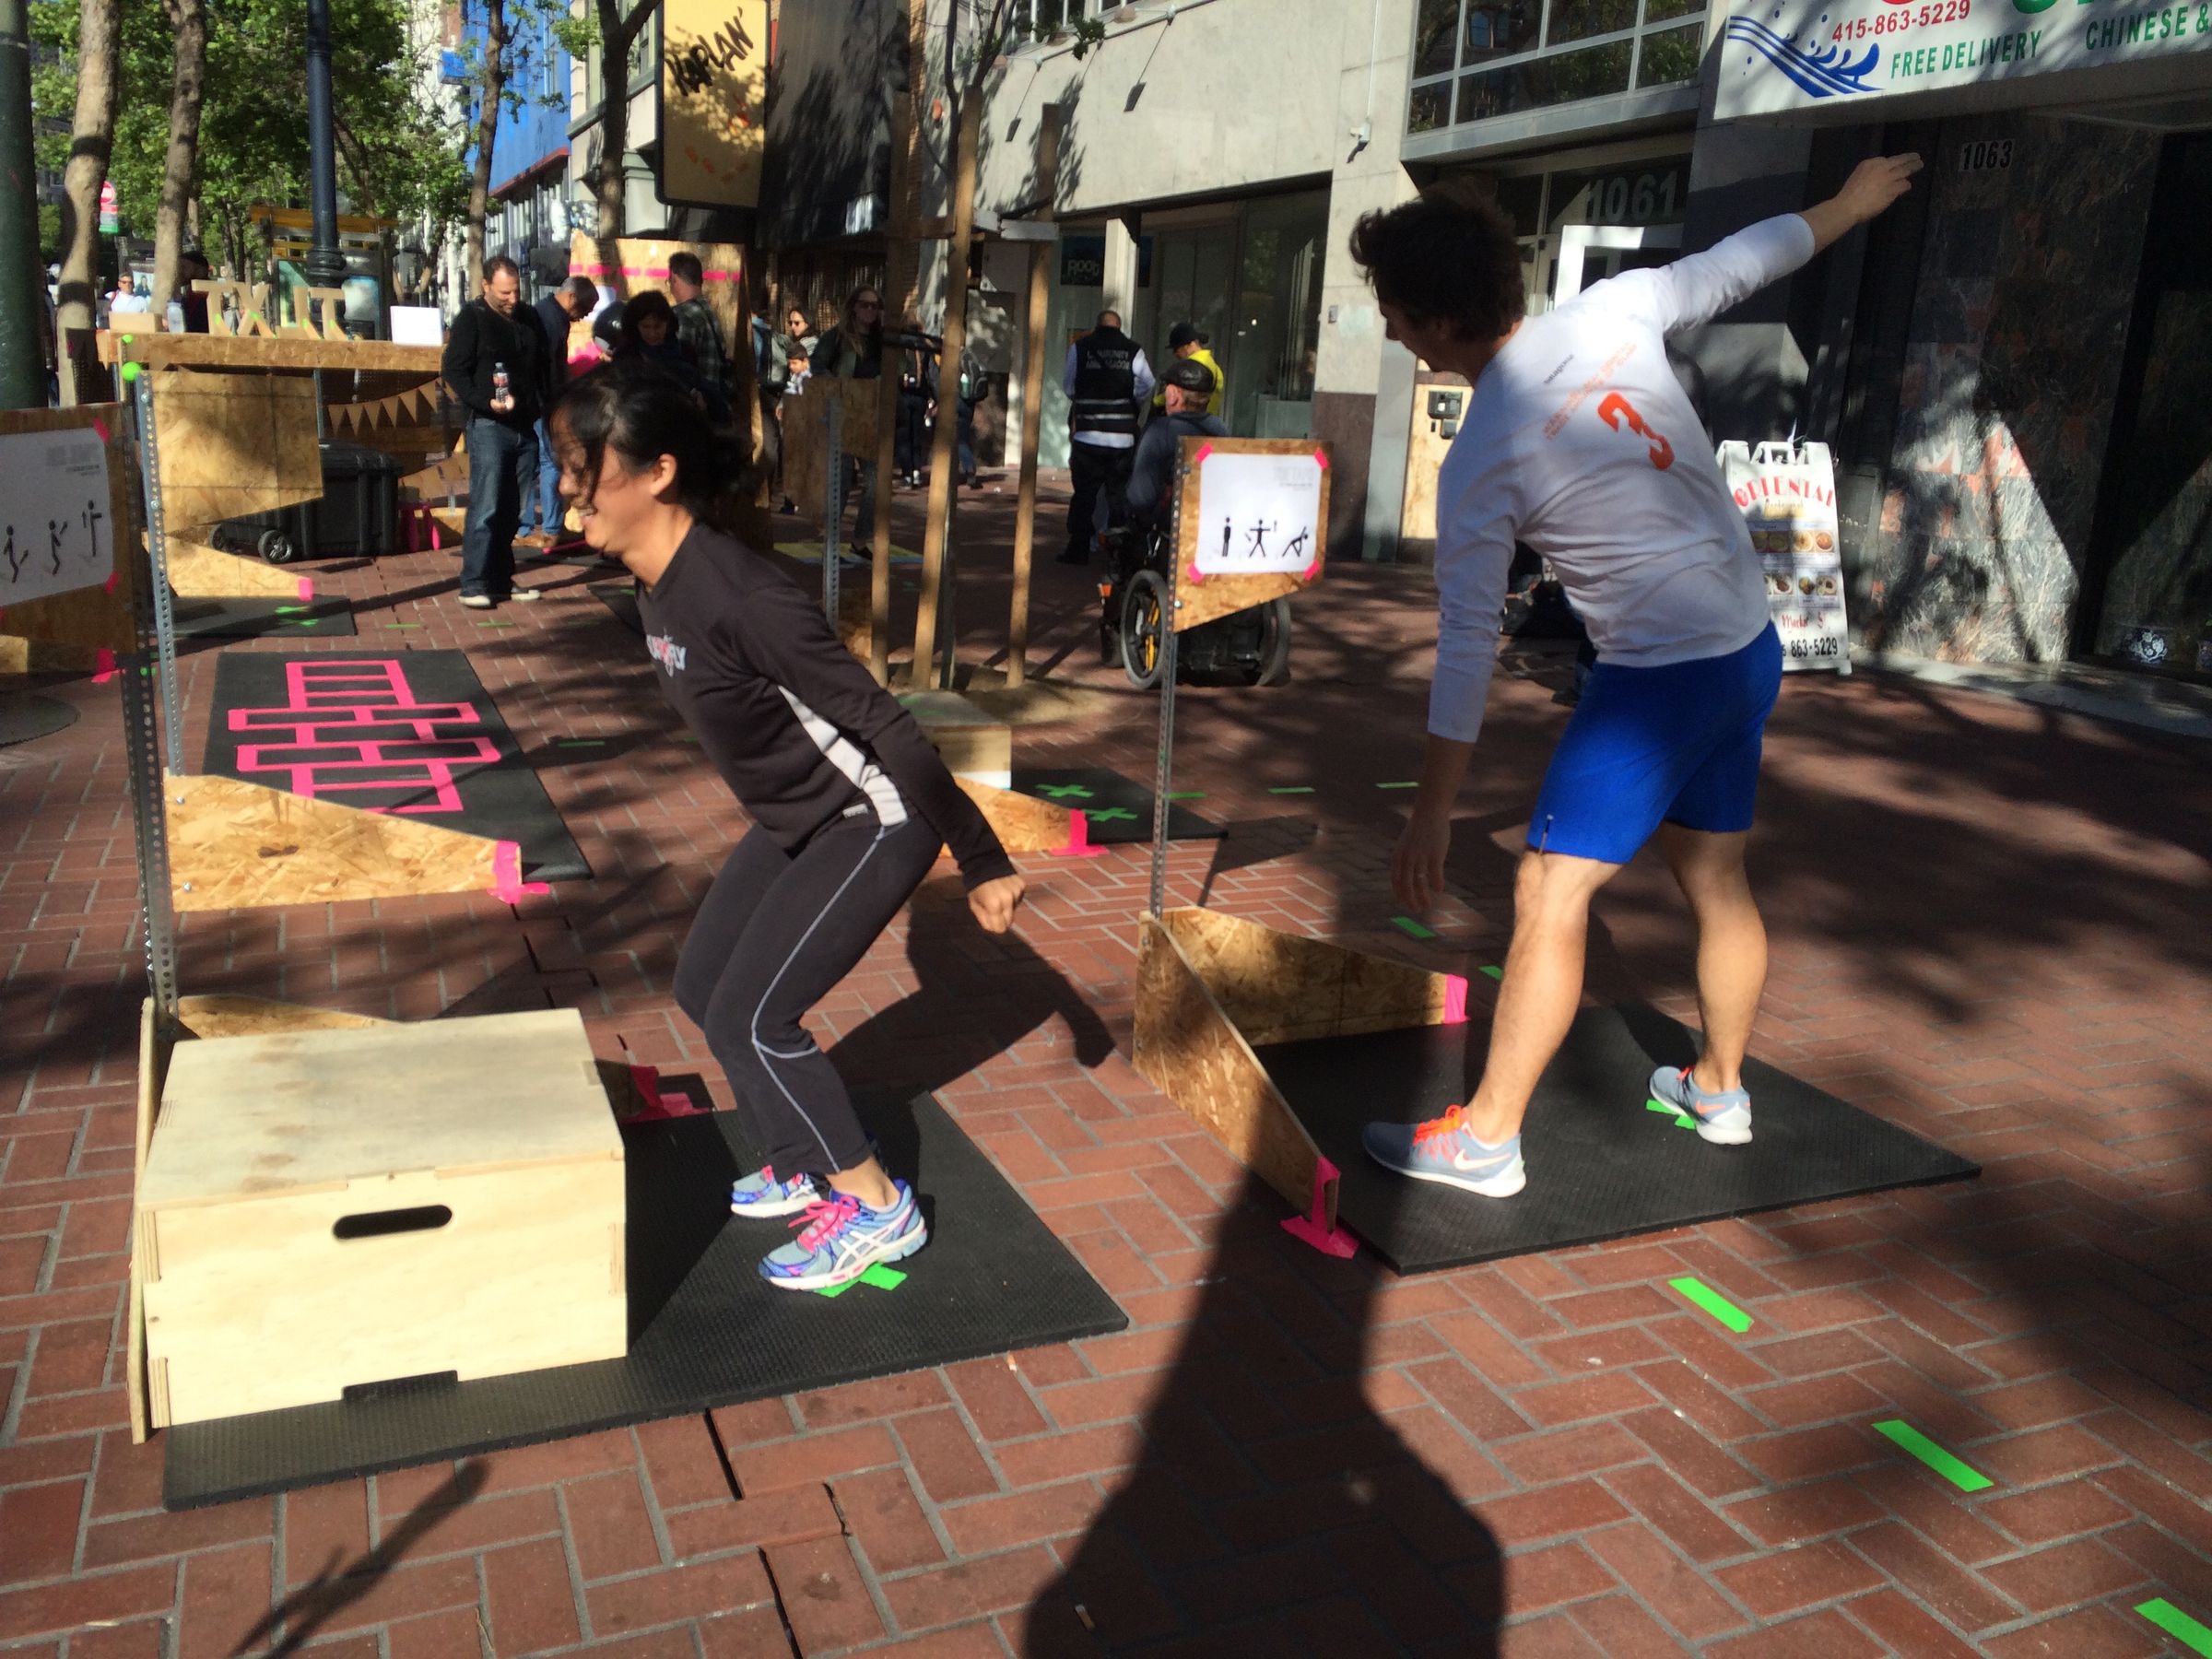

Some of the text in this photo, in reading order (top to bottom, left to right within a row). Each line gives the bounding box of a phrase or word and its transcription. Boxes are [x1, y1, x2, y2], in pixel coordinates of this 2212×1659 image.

[1831, 0, 1971, 42] 415-863-5229
[2085, 2, 2211, 51] CHINESE &
[1890, 29, 2042, 79] FREE DELIVERY
[1962, 139, 2013, 171] 1063
[1586, 171, 1678, 224] 1061
